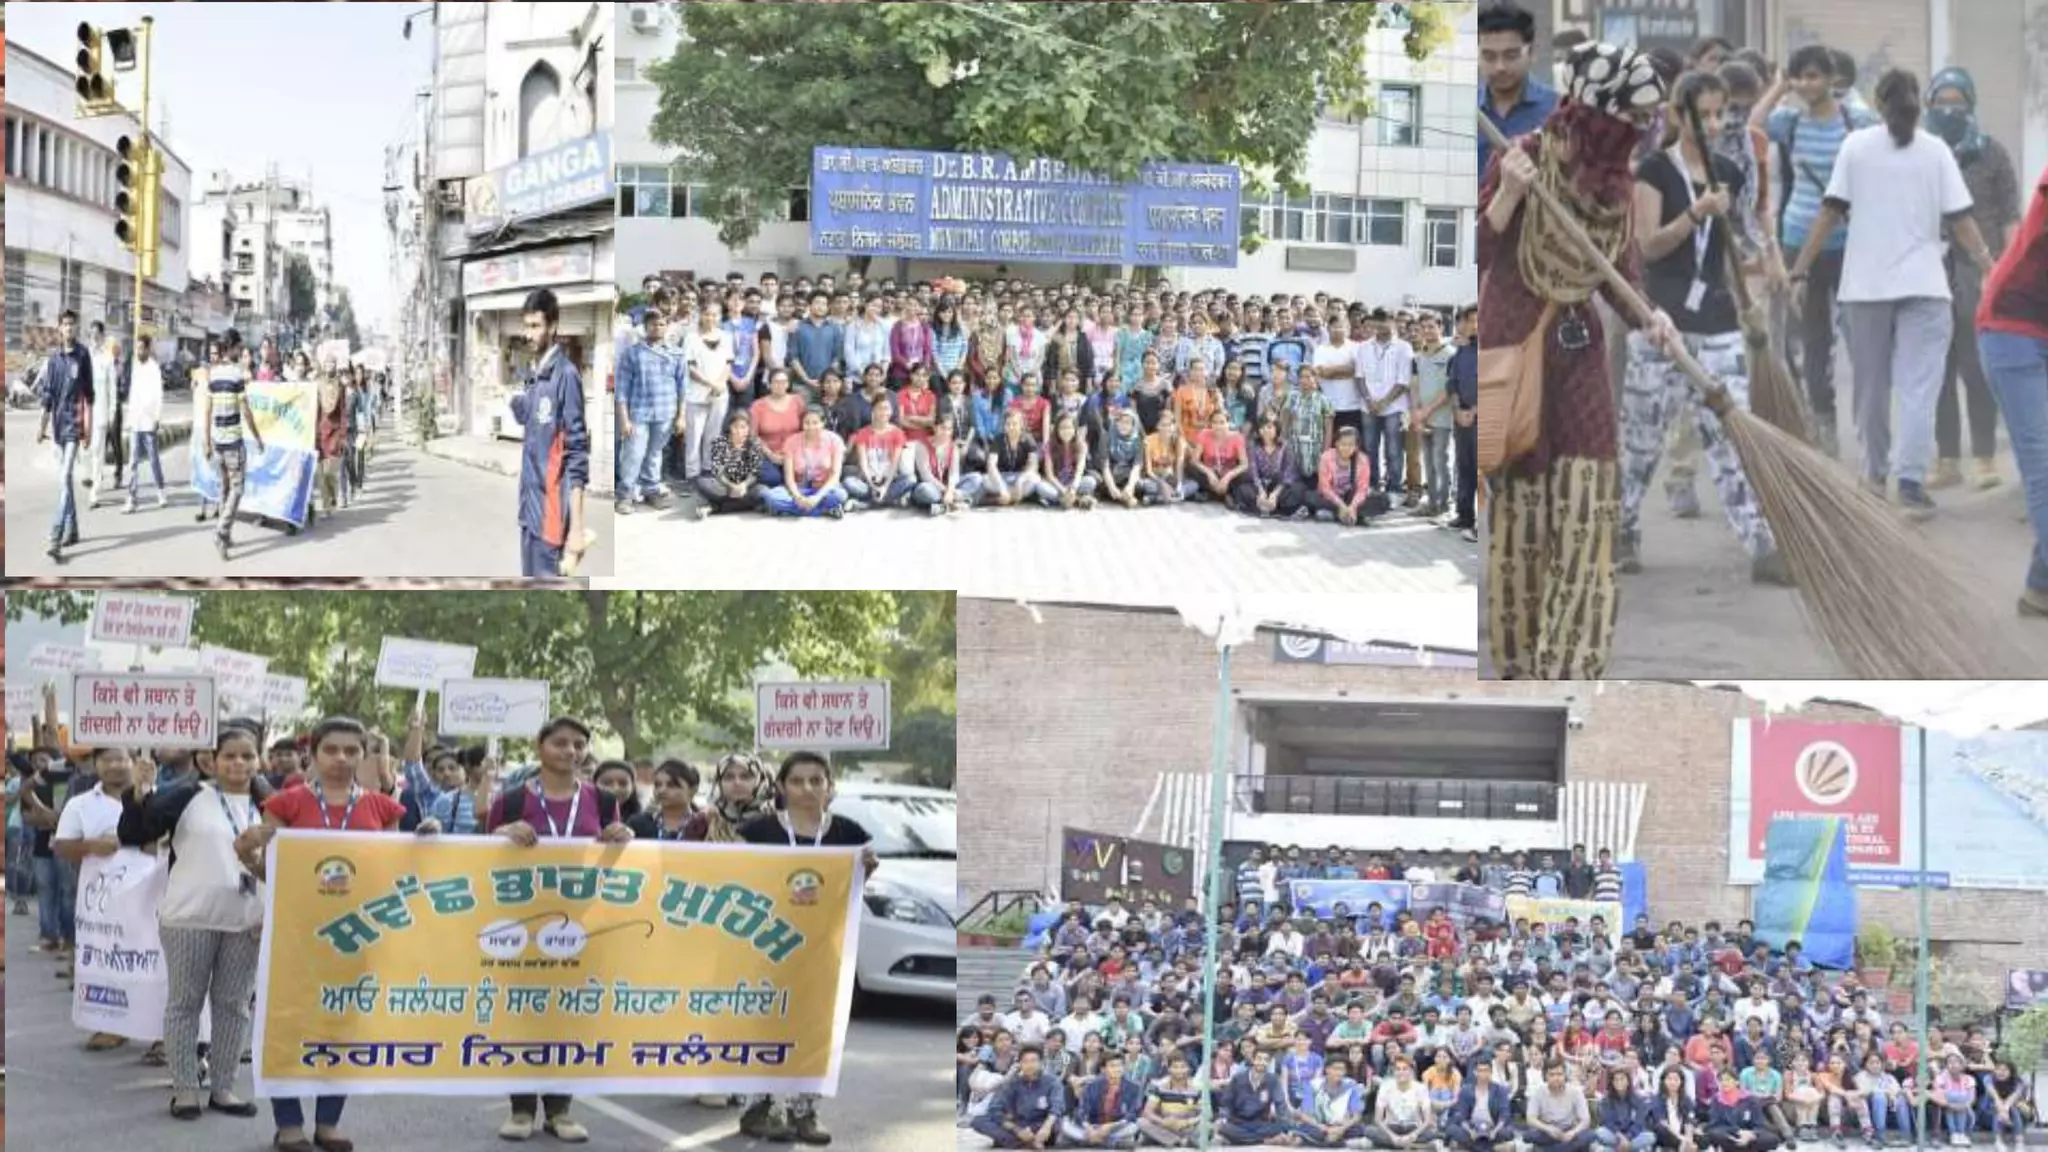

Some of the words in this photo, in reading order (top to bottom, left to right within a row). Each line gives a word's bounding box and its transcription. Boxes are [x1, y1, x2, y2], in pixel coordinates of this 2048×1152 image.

[506, 139, 603, 196] GANGA
[930, 186, 1056, 224] ADMINISTRATIVE
[929, 227, 985, 253] MUNICIPAL
[92, 680, 119, 706] ਕਿਸੇ
[774, 688, 799, 711] ਕਿਸੇ
[80, 709, 123, 735] ਗੰਦਗੀ
[126, 714, 143, 735] ਨਾ
[763, 715, 803, 739] ਗੰਦਗੀ
[805, 718, 821, 738] ਨਾ
[317, 873, 477, 955] ਸਵੱਛ
[491, 865, 648, 906] ਭਾਰਤ
[659, 876, 806, 964] ਮੁਹਿੰਮ
[388, 976, 470, 1013] ਜਲੰਧਰ
[475, 976, 500, 1023] ਨੂੰ
[506, 986, 550, 1013] ਸਾਫ
[558, 977, 605, 1014] ਅਤੇ
[612, 980, 681, 1014] ਸੋਹਣਾ
[302, 1041, 444, 1067] ਨਗਰ
[461, 1034, 614, 1067] ਨਿਗਮ
[631, 1032, 796, 1066] ਜਲੰਧਰ
